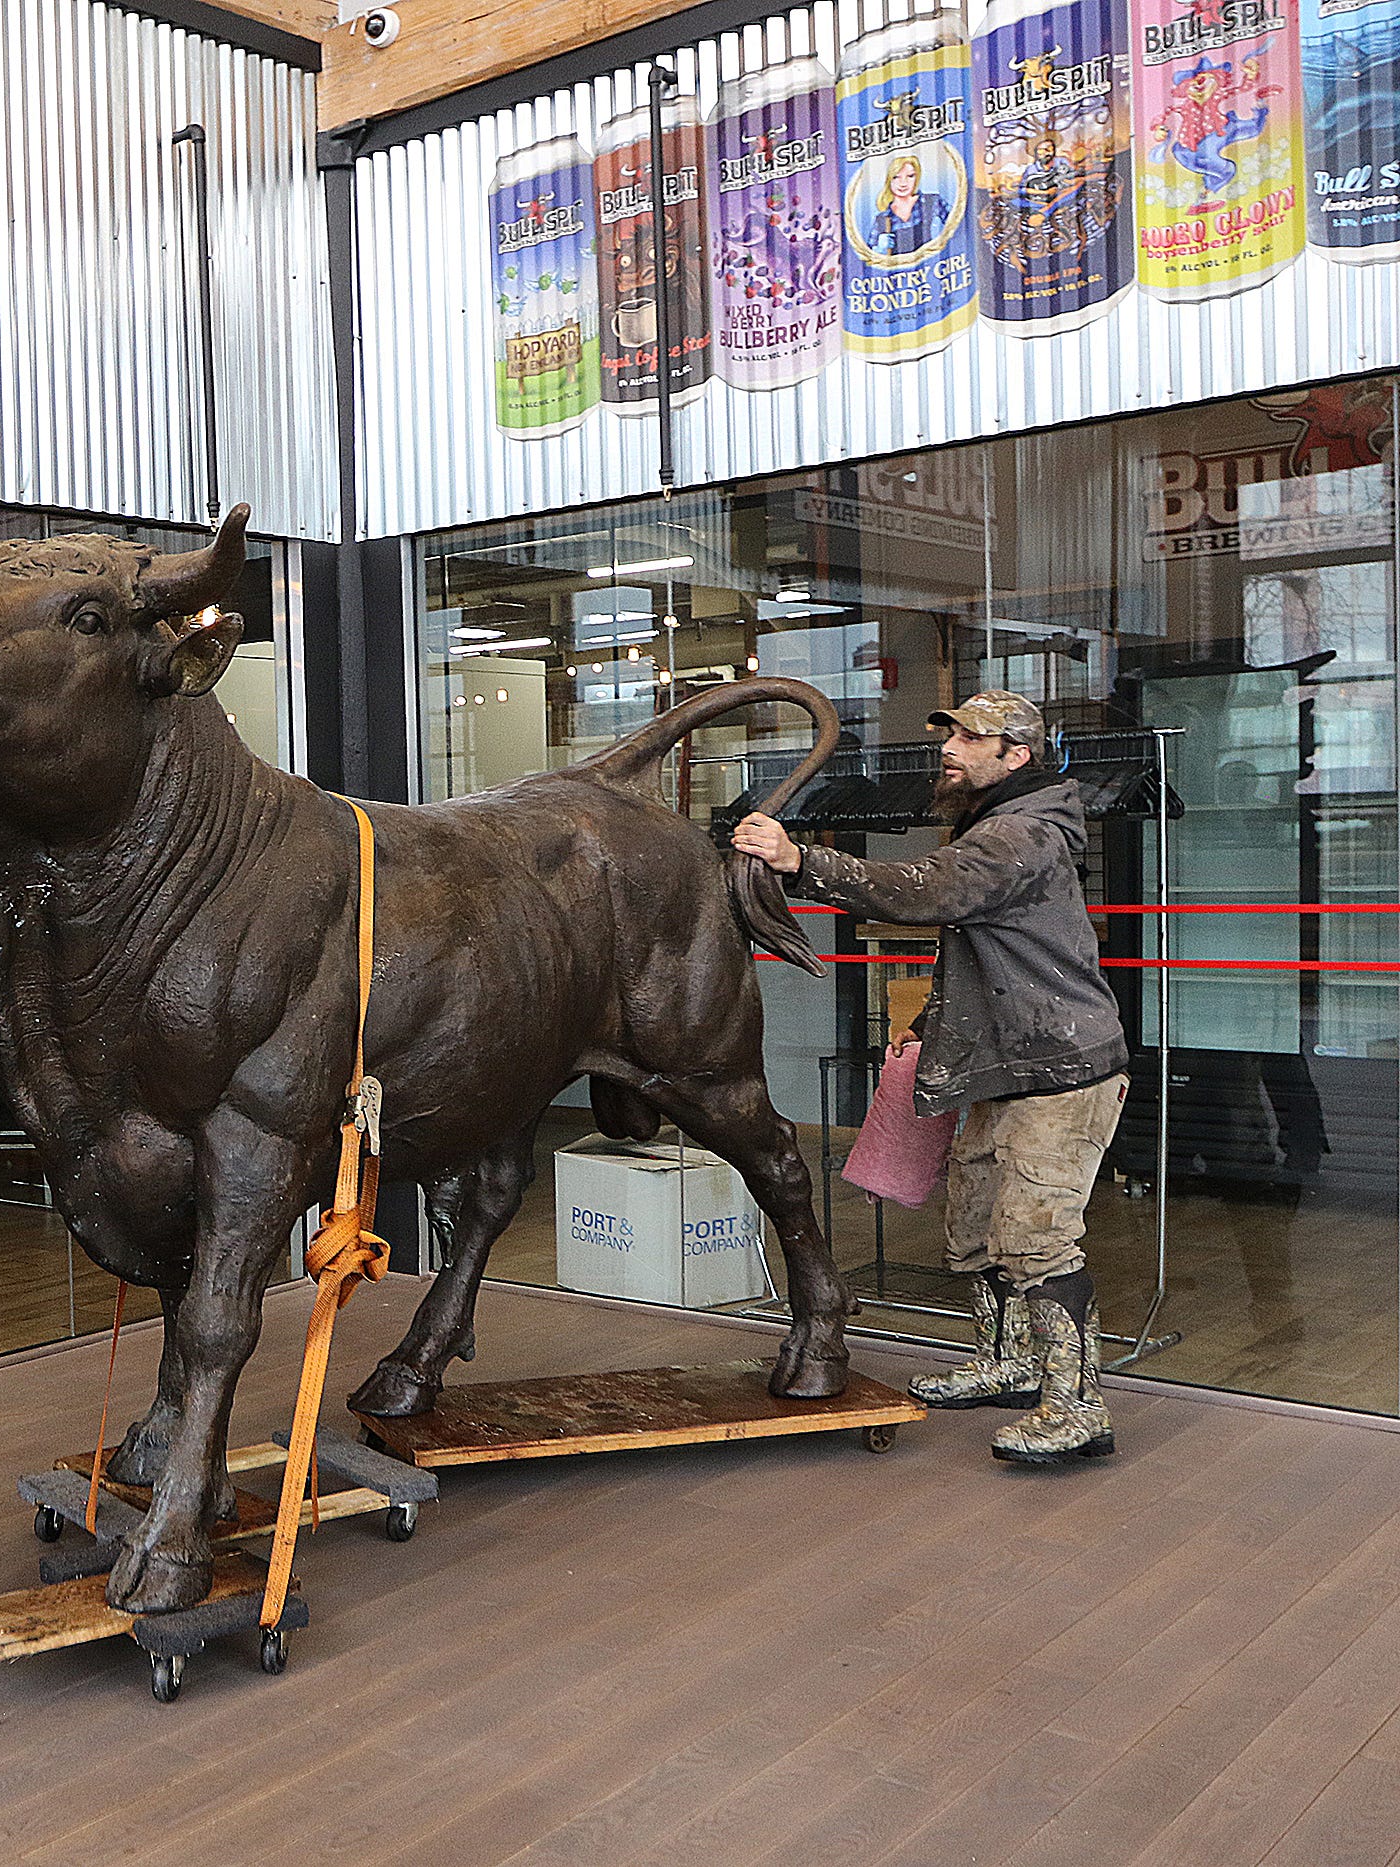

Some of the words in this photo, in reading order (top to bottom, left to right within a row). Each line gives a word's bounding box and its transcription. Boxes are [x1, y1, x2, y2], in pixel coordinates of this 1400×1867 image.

[1144, 12, 1220, 53] BULL
[983, 80, 1047, 115] BULL
[1049, 54, 1112, 97] SPIT
[847, 115, 906, 152] BULL
[910, 97, 964, 133] SPIT
[774, 130, 824, 168] SPIT
[1313, 164, 1372, 195] Bull
[1214, 187, 1296, 236] CLOWN
[1253, 213, 1286, 237] sour
[846, 283, 934, 314] BLONDE
[940, 268, 973, 299] ALE
[850, 266, 932, 295] COUNTRY
[933, 253, 971, 280] GIRL
[719, 318, 810, 350] BULLBERRY
[815, 305, 838, 334] ALE
[731, 313, 774, 330] BERRY
[571, 1206, 617, 1233] PORT
[619, 1217, 634, 1236] &
[571, 1226, 634, 1253] COMPANY
[683, 1216, 738, 1239] PORT
[740, 1212, 754, 1231] &
[684, 1234, 756, 1257] COMPANY
